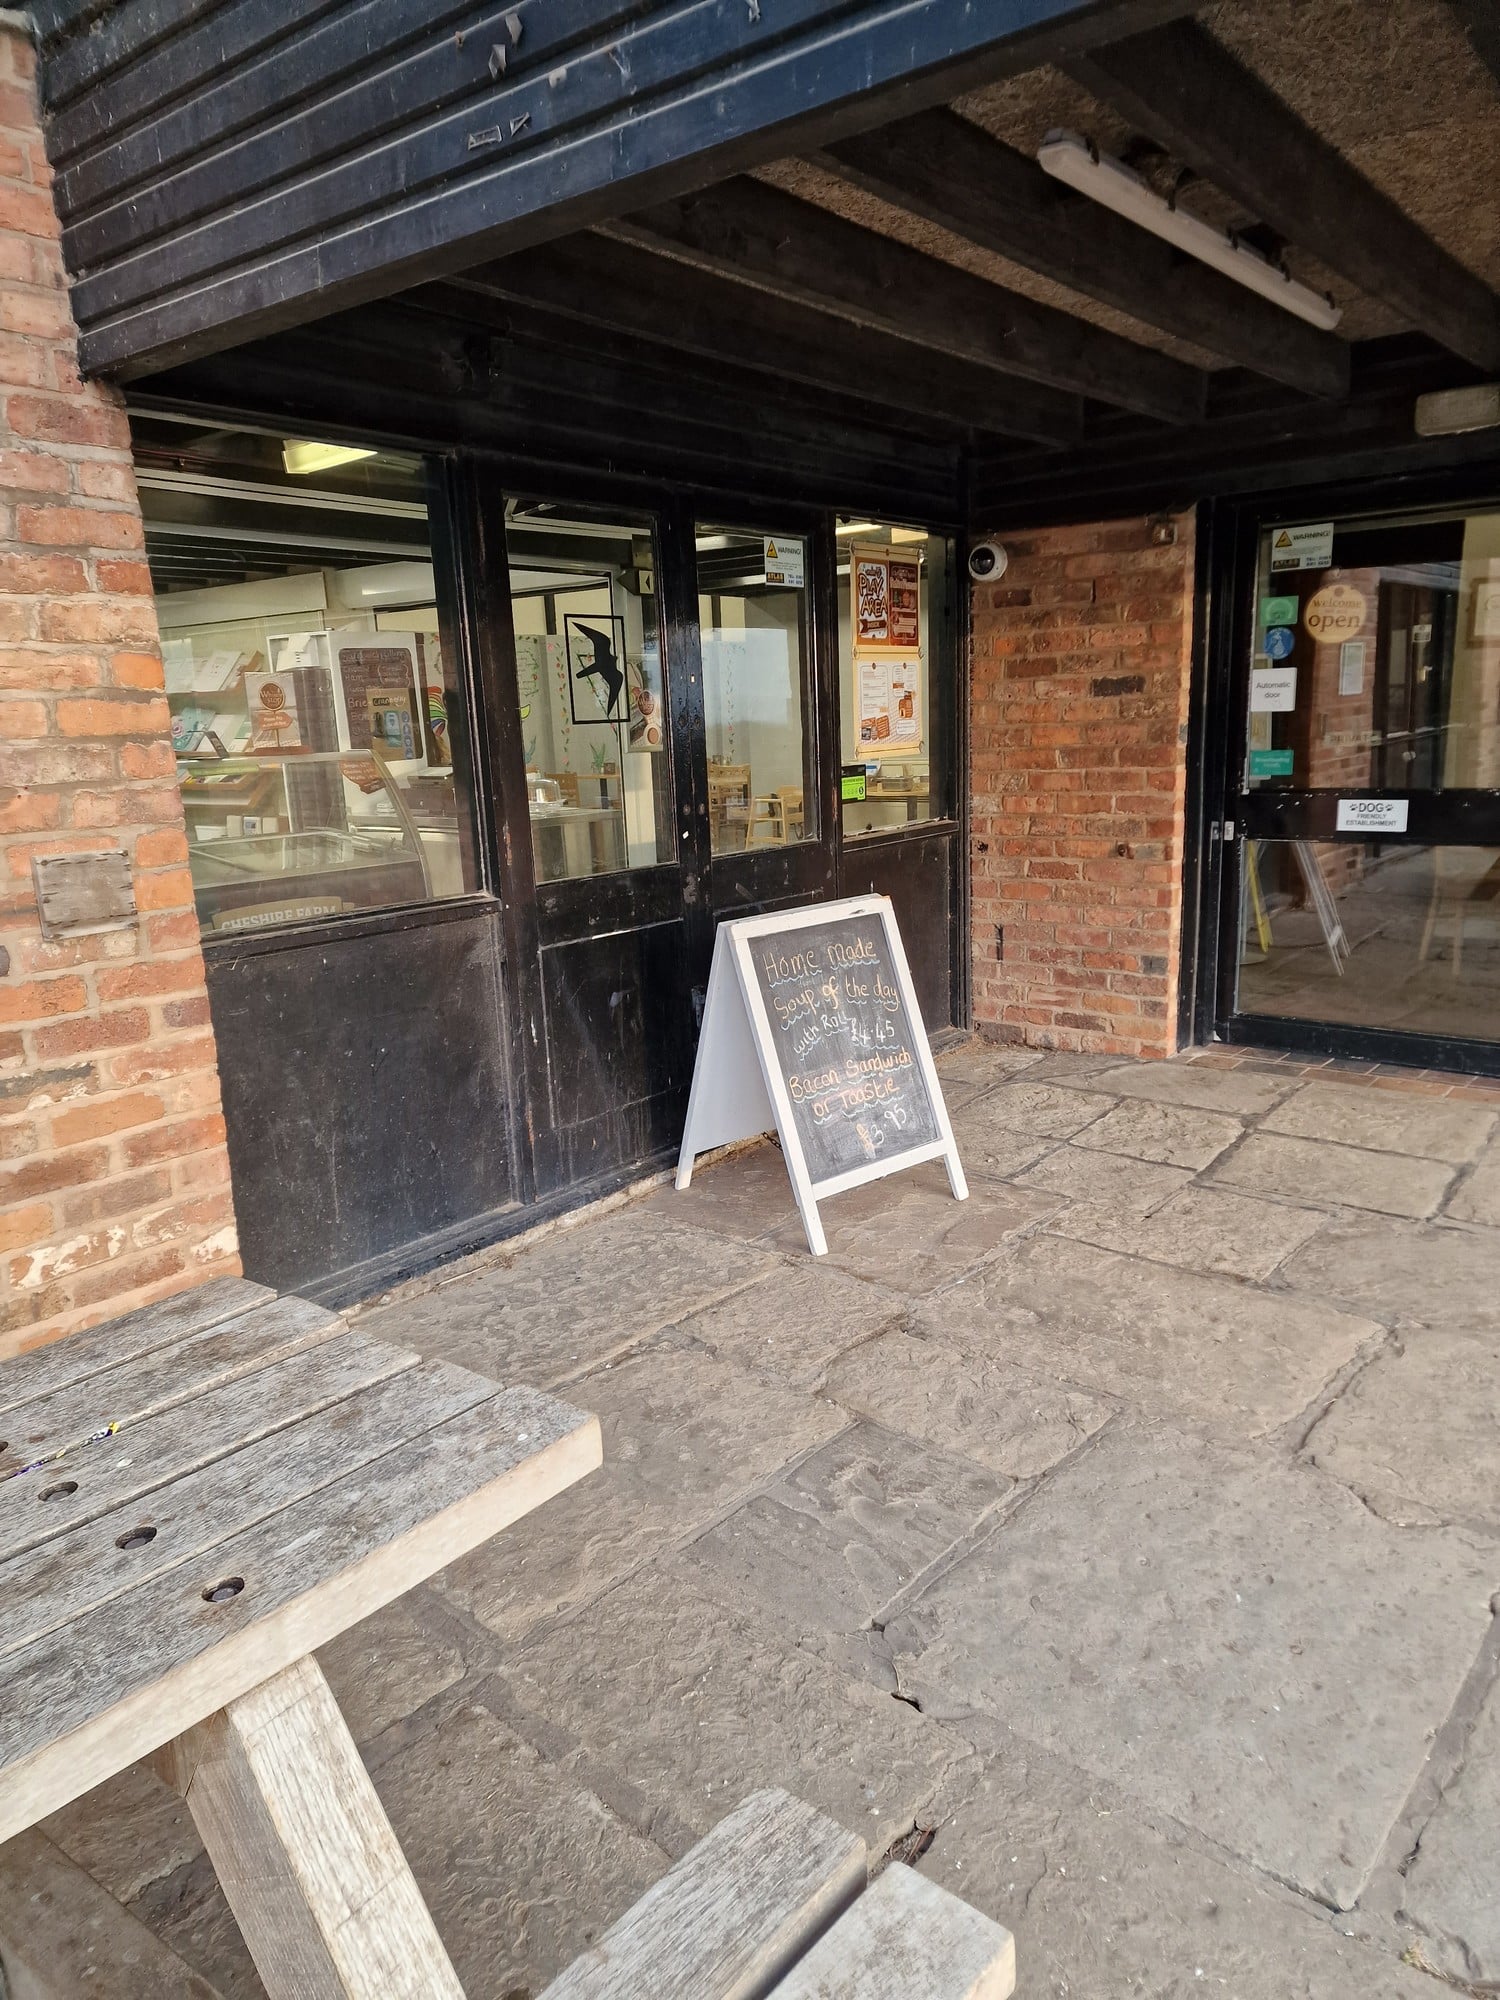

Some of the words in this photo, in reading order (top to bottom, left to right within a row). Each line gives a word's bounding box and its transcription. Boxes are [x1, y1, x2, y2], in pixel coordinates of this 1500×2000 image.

[858, 573, 884, 597] PLAY
[861, 596, 888, 617] AREA
[1308, 615, 1360, 632] open
[1359, 803, 1384, 812] DOG
[221, 909, 293, 930] CHESHIRE
[762, 950, 819, 982] Home
[827, 937, 876, 966] Made
[773, 989, 818, 1019] Soup
[822, 976, 839, 1010] of
[845, 974, 870, 998] the
[873, 974, 899, 1012] day
[793, 1025, 820, 1054] with
[789, 1069, 841, 1098] Bacon
[845, 1045, 912, 1077] Sandwich
[812, 1099, 831, 1117] or
[840, 1077, 900, 1109] Toastie
